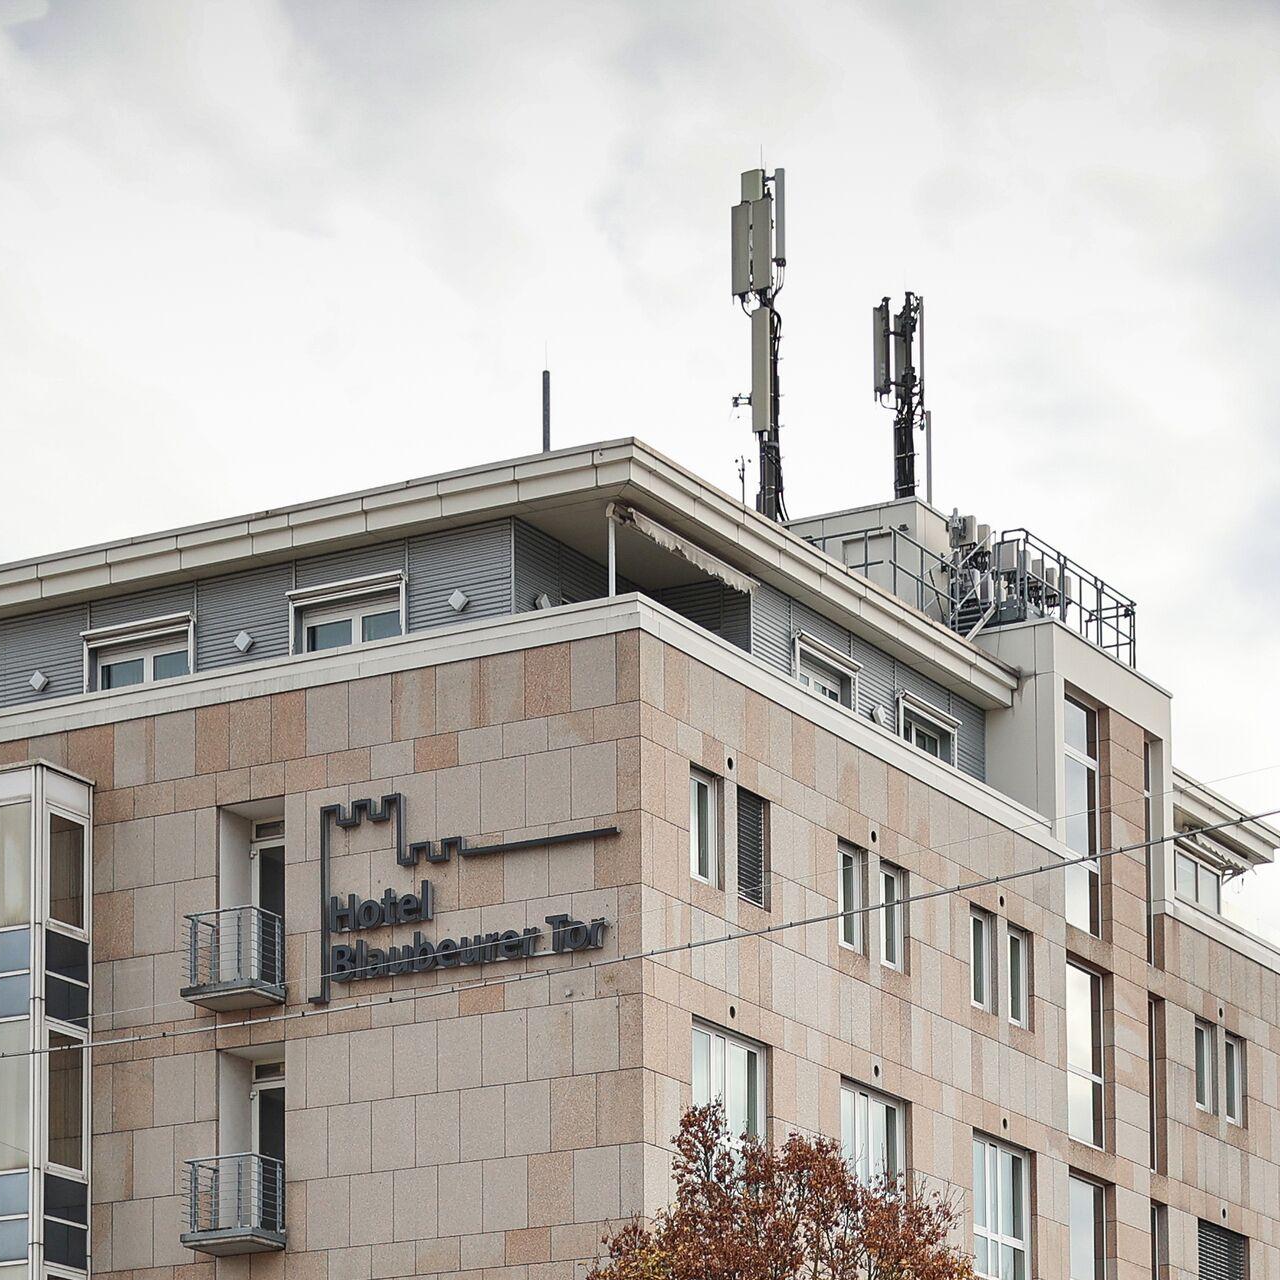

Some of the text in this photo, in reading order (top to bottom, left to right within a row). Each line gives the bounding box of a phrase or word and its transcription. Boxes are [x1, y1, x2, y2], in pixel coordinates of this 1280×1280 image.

[330, 879, 434, 933] Hotel
[331, 912, 611, 984] Blaubeurer Tor
